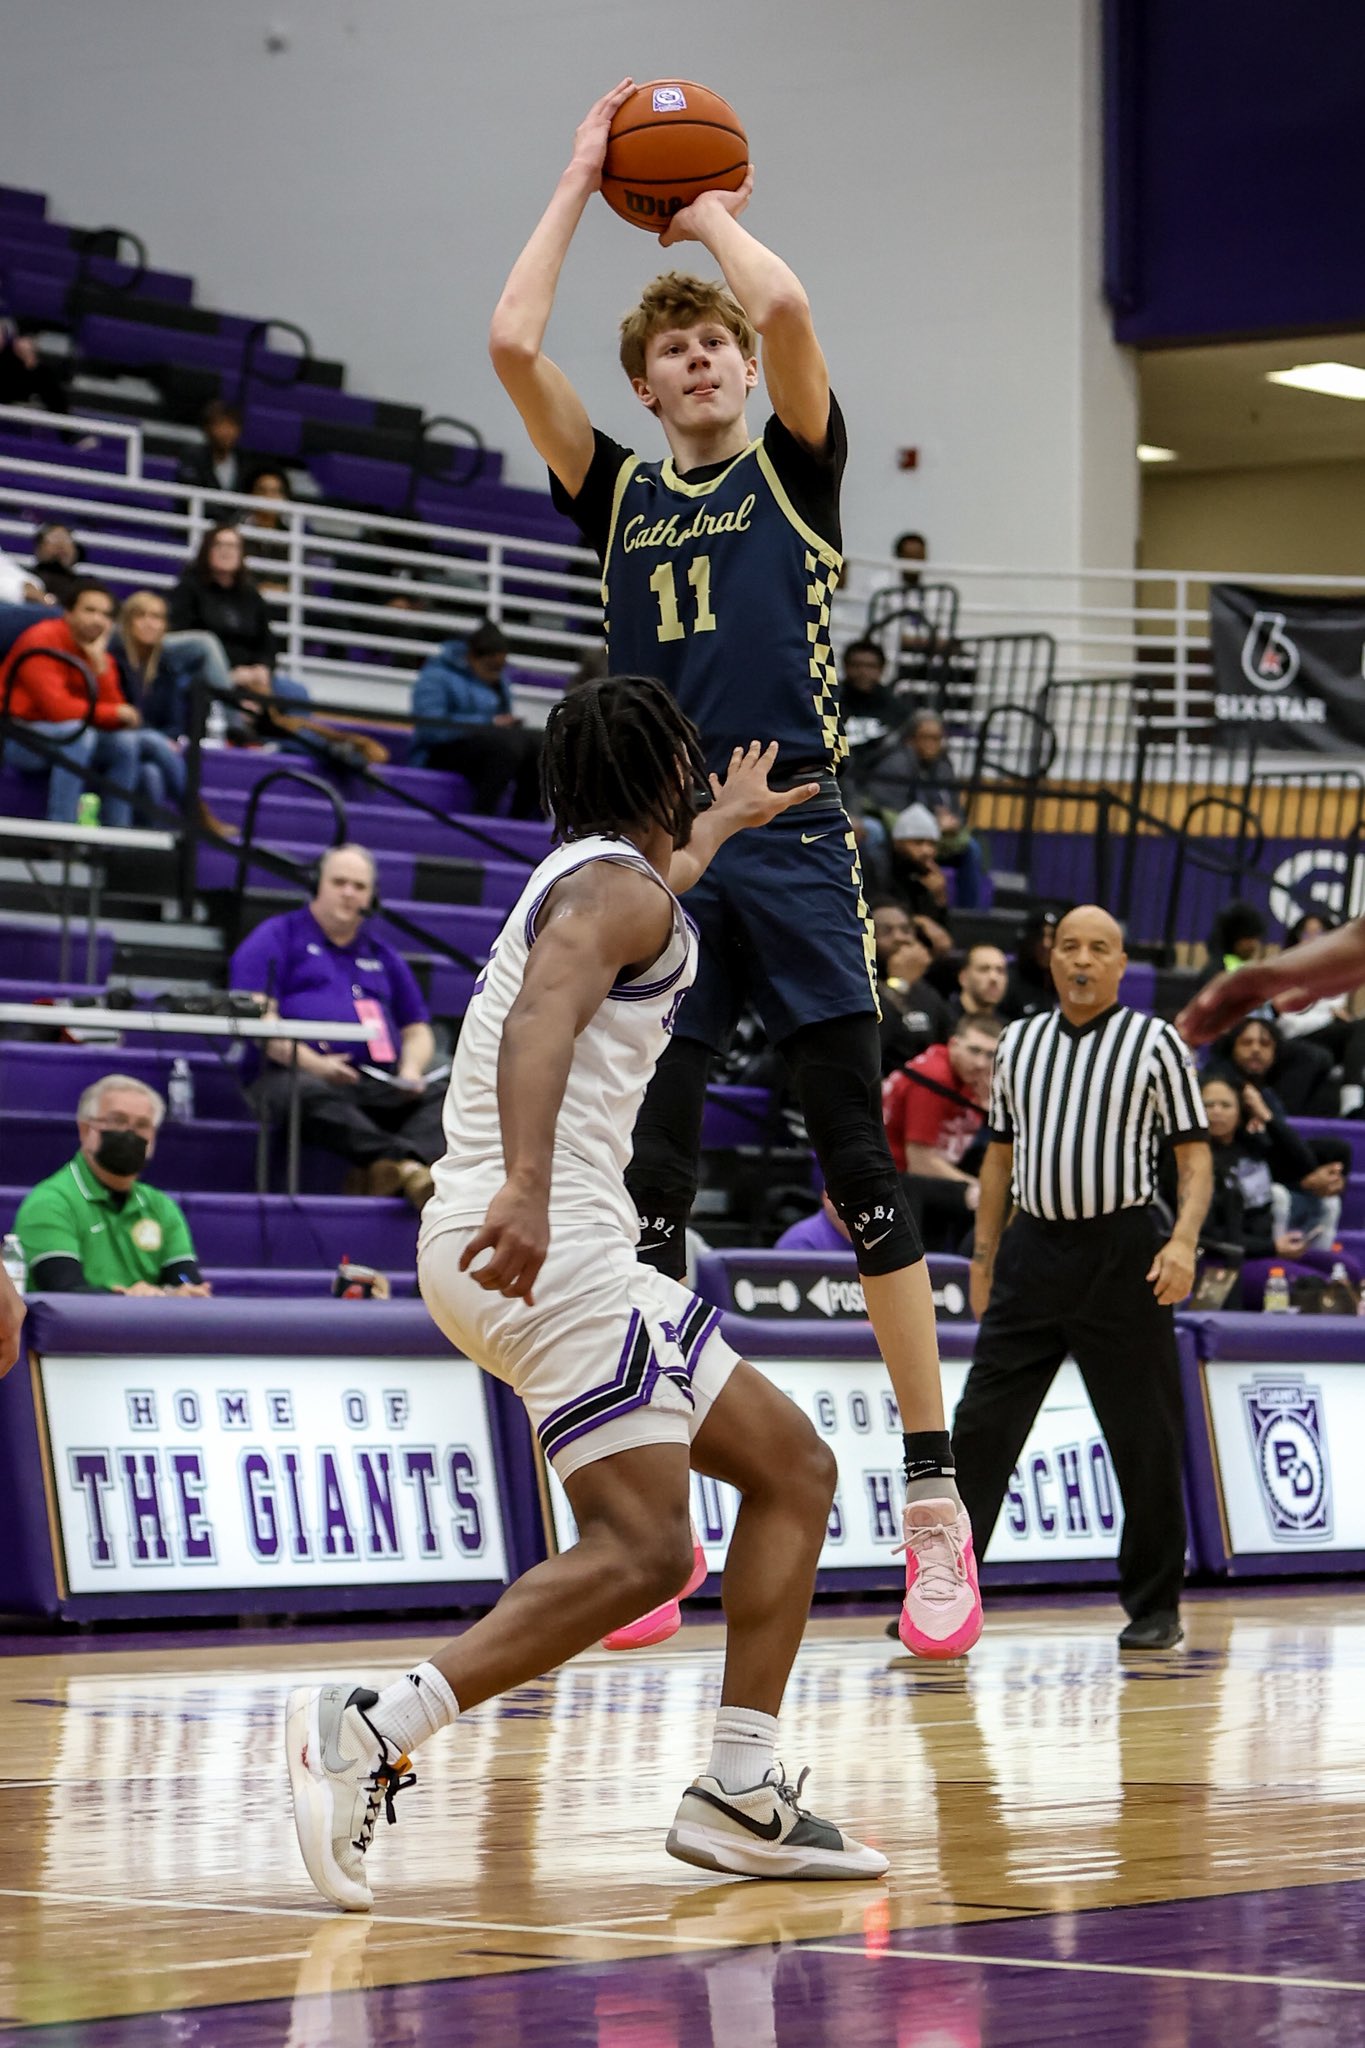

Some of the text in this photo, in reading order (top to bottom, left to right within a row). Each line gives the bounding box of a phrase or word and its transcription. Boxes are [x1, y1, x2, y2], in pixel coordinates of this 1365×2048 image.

[649, 555, 717, 643] 11
[1214, 694, 1327, 723] SIXSTAR
[639, 1215, 675, 1238] YBL
[827, 1281, 868, 1312] POS
[125, 1389, 409, 1431] HOME OF
[67, 1444, 488, 1568] THE GIANTS
